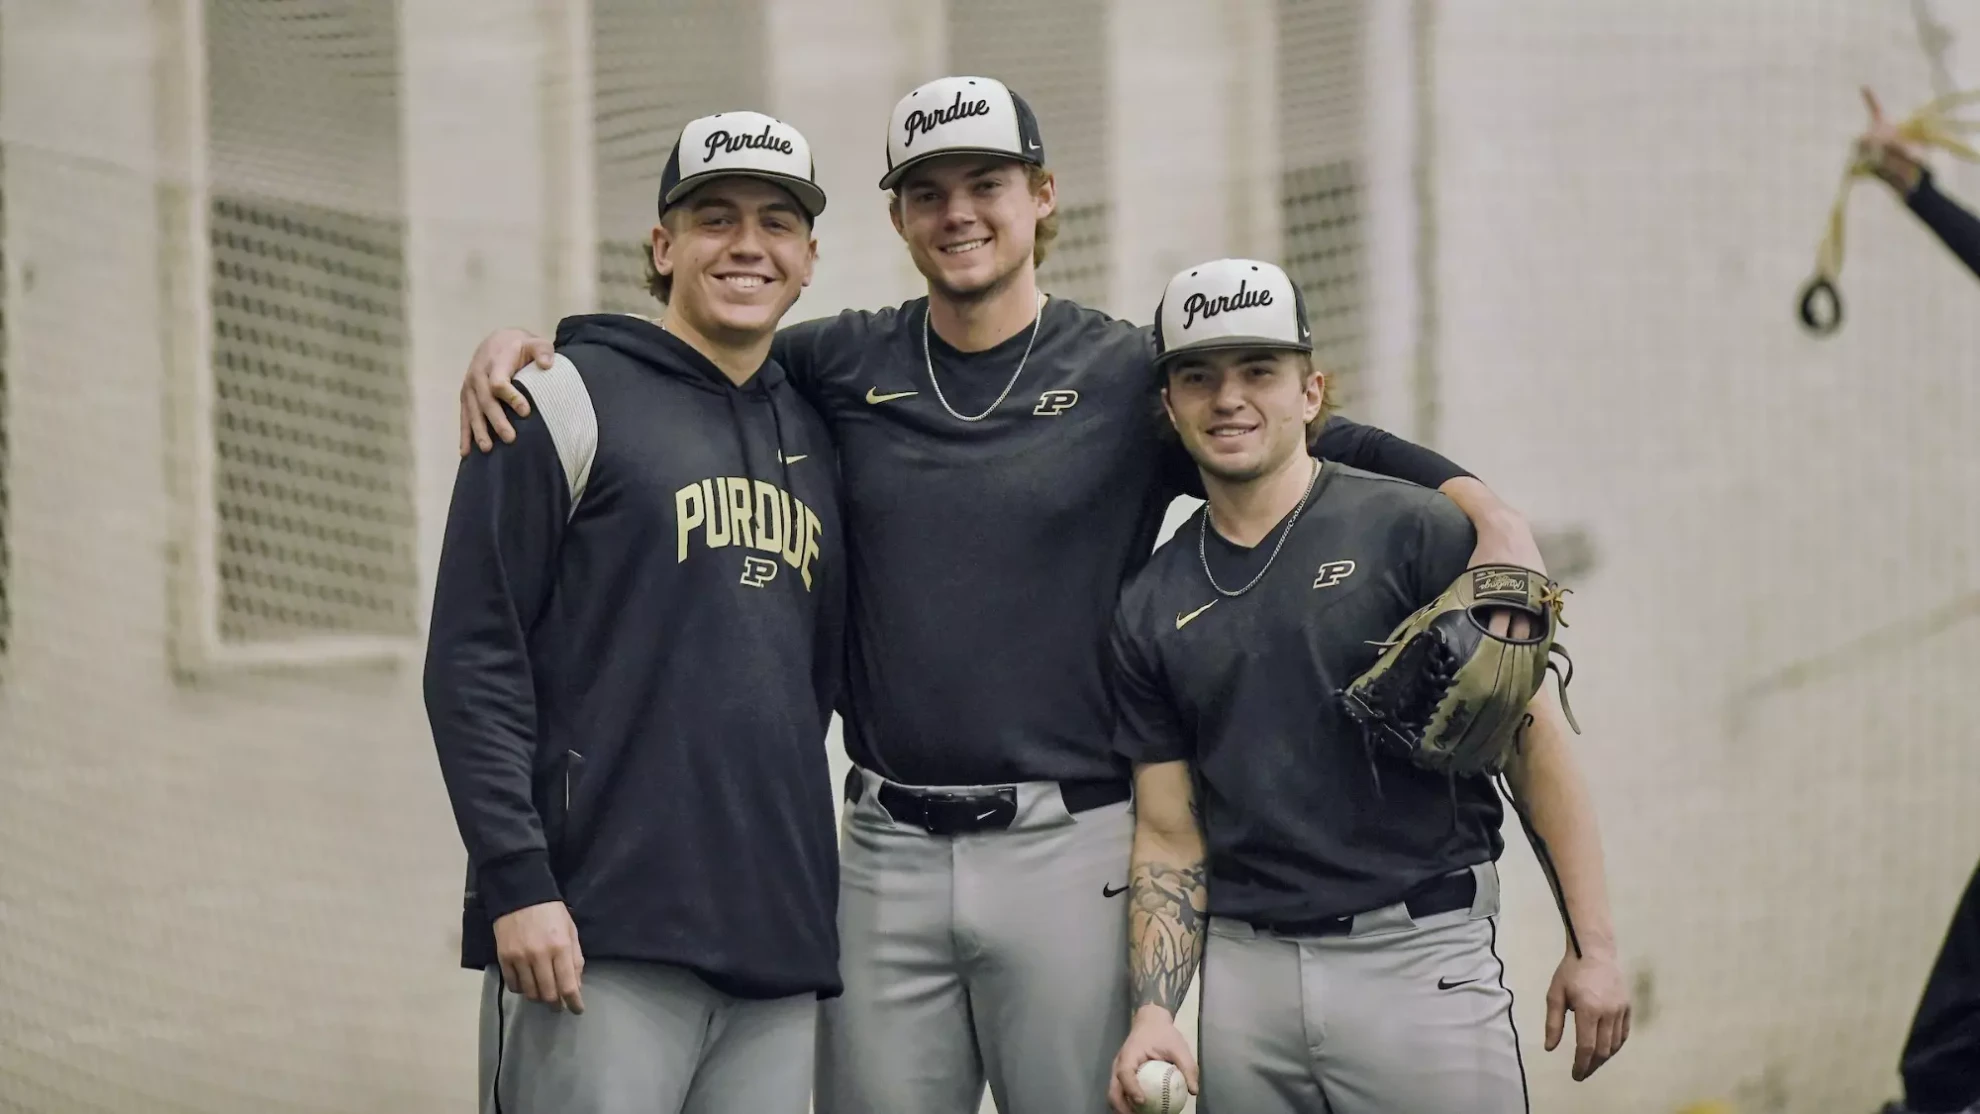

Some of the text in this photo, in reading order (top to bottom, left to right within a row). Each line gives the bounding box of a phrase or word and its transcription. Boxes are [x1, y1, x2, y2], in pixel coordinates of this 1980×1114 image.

[904, 91, 990, 147] Purdue
[703, 124, 793, 163] Purdue
[1183, 279, 1273, 330] Purdue
[1033, 390, 1079, 416] P
[675, 477, 823, 593] PURDUE
[740, 555, 778, 588] P
[1313, 560, 1356, 589] P
